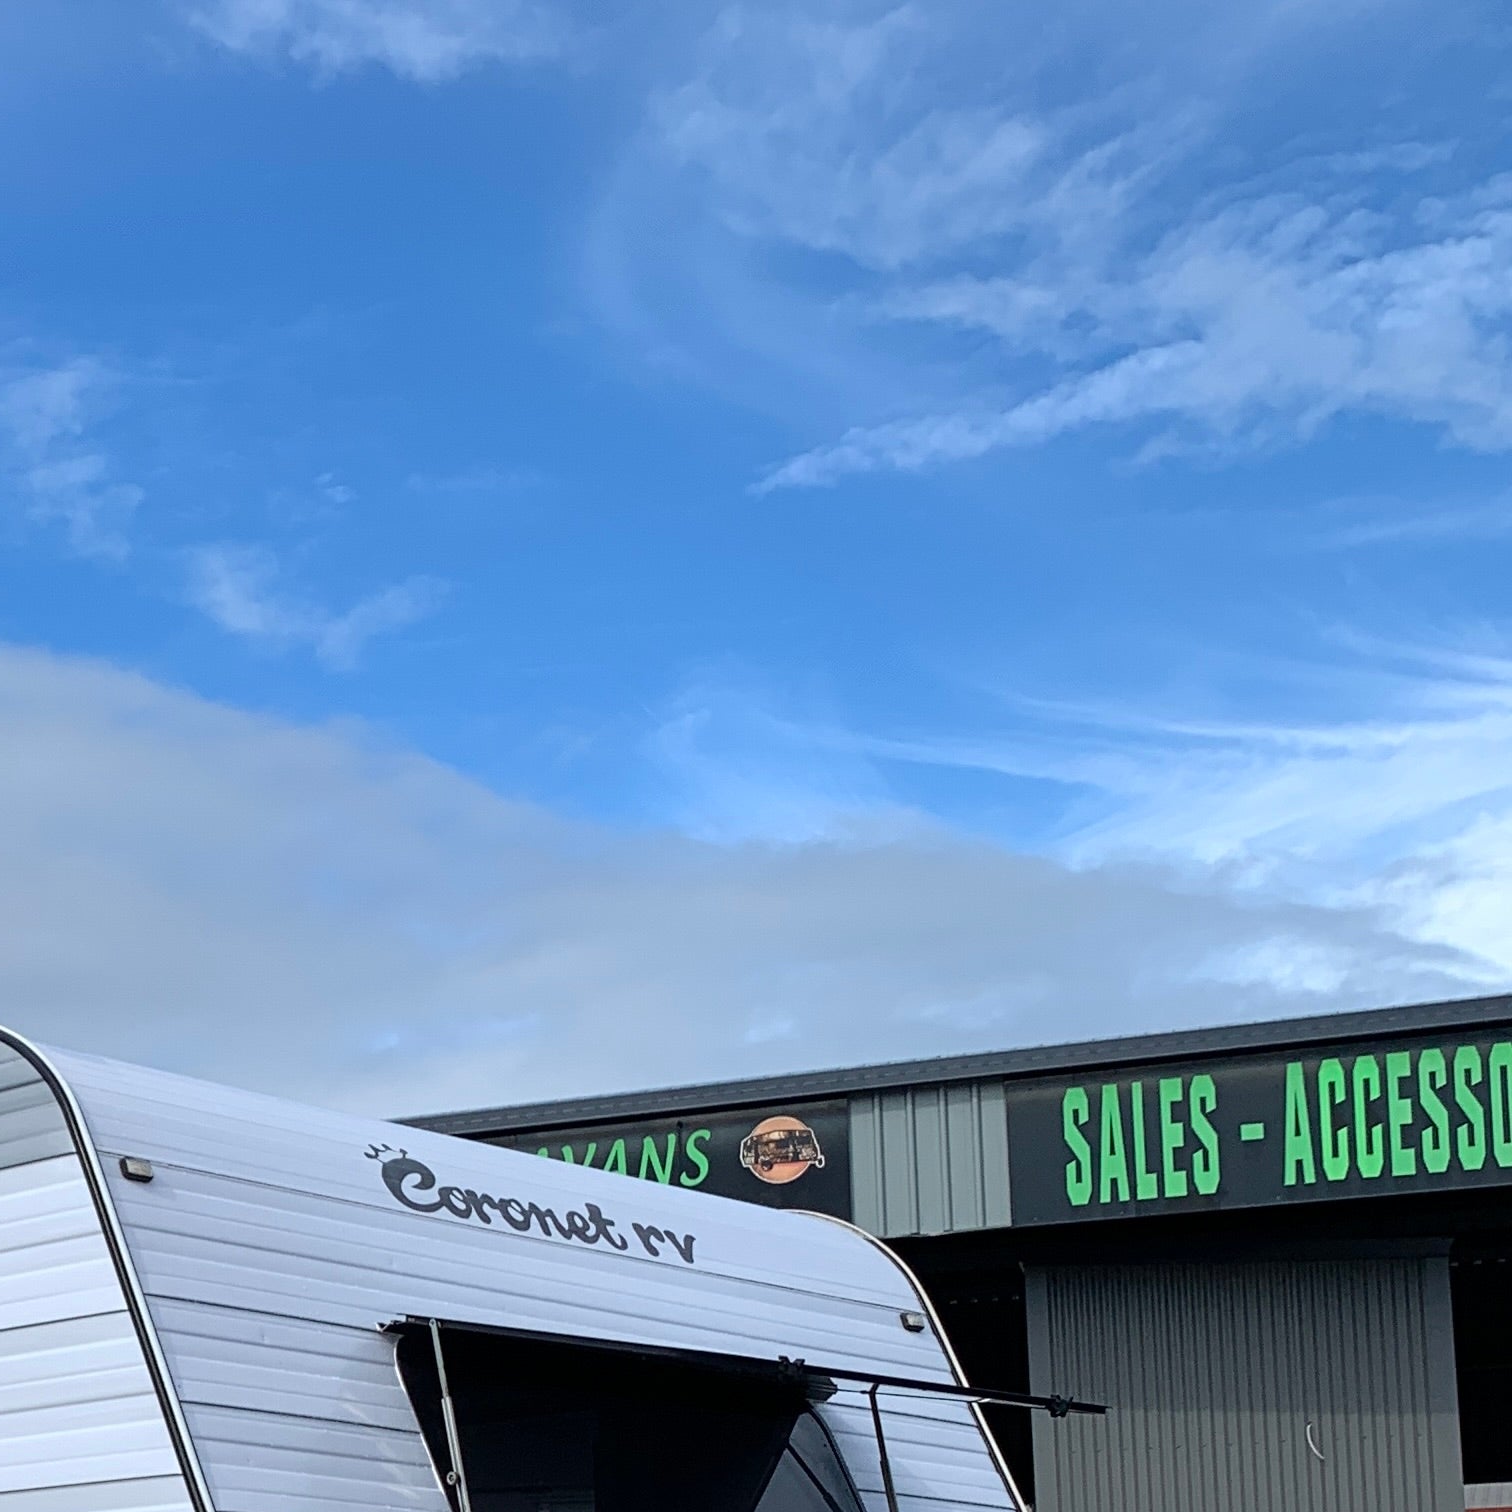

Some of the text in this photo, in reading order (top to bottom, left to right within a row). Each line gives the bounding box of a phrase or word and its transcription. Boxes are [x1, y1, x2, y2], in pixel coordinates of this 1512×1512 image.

[1062, 1073, 1221, 1206] SALES
[1283, 1041, 1512, 1186] ACCESSO
[381, 1157, 697, 1264] Coronet rv
